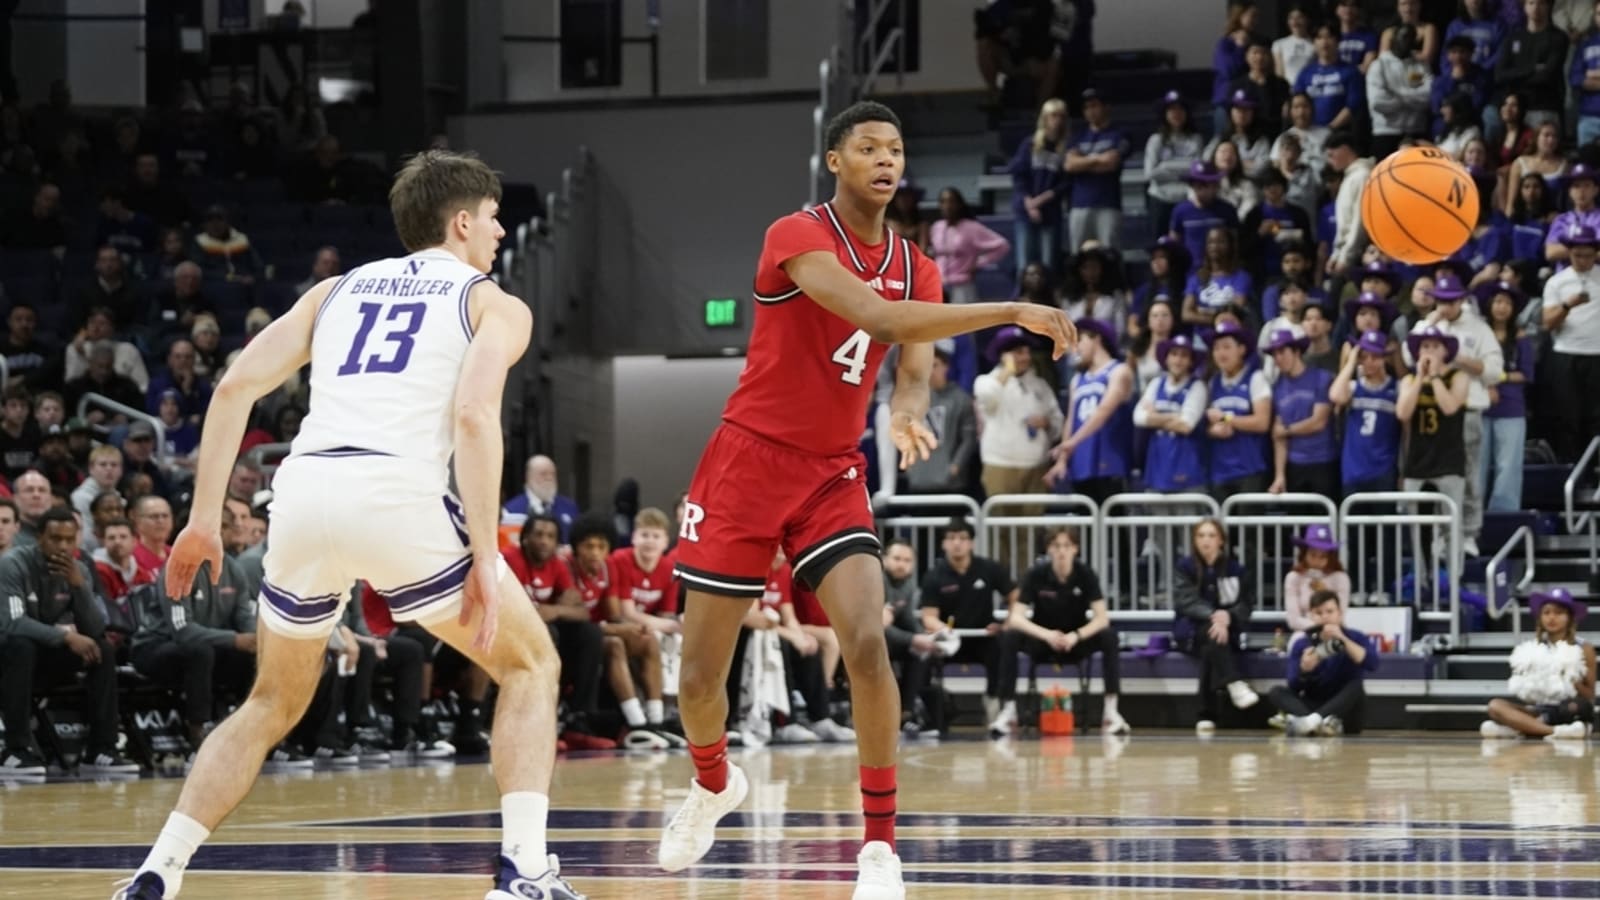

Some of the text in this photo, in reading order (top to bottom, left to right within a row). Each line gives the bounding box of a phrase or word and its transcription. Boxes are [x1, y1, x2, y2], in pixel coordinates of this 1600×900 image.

[1447, 178, 1468, 209] N
[403, 260, 425, 275] N
[350, 277, 454, 297] BARNHIZER
[337, 302, 427, 376] 13
[831, 328, 871, 386] 4
[1360, 410, 1377, 436] 3
[1418, 408, 1438, 436] 13
[679, 502, 705, 542] R
